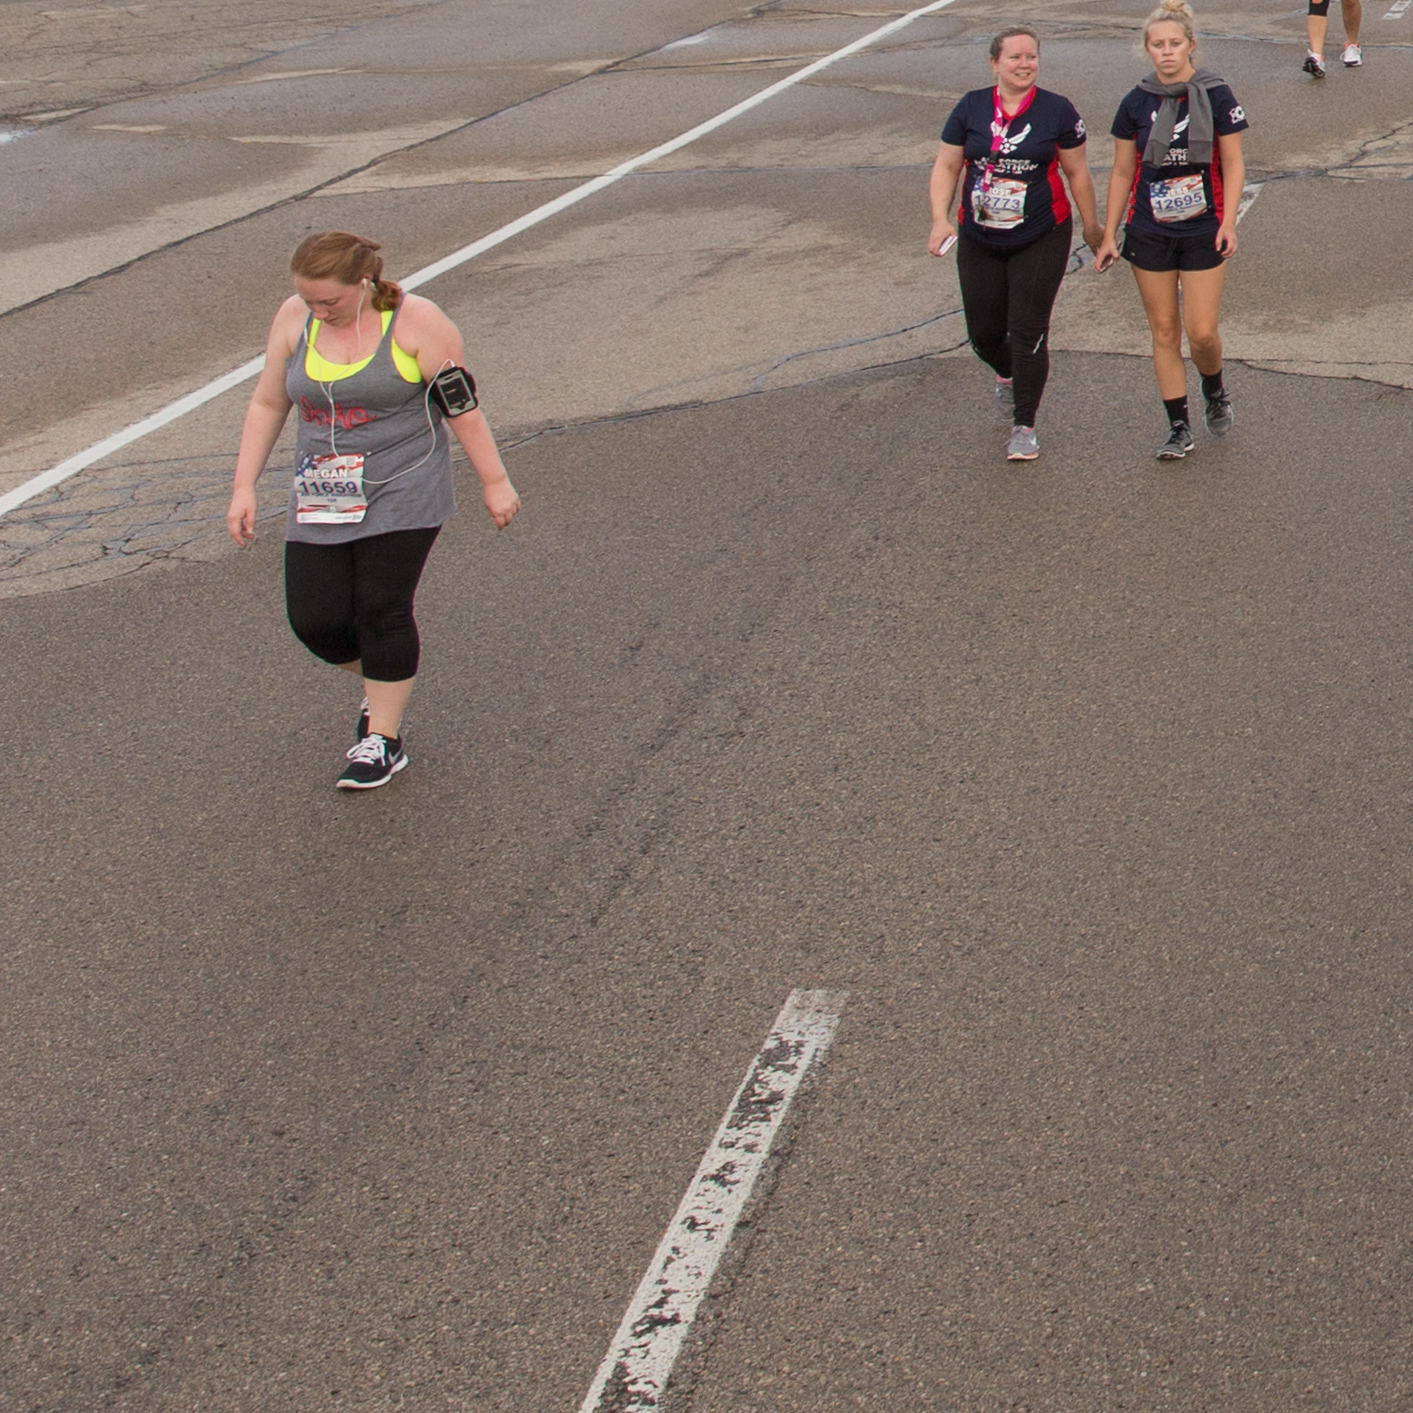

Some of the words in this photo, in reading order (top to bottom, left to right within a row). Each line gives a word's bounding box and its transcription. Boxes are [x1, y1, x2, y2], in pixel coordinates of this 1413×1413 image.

[975, 194, 1021, 209] 12773
[1154, 191, 1203, 210] 12695
[304, 468, 349, 478] MEGAN
[299, 480, 358, 494] 11659
